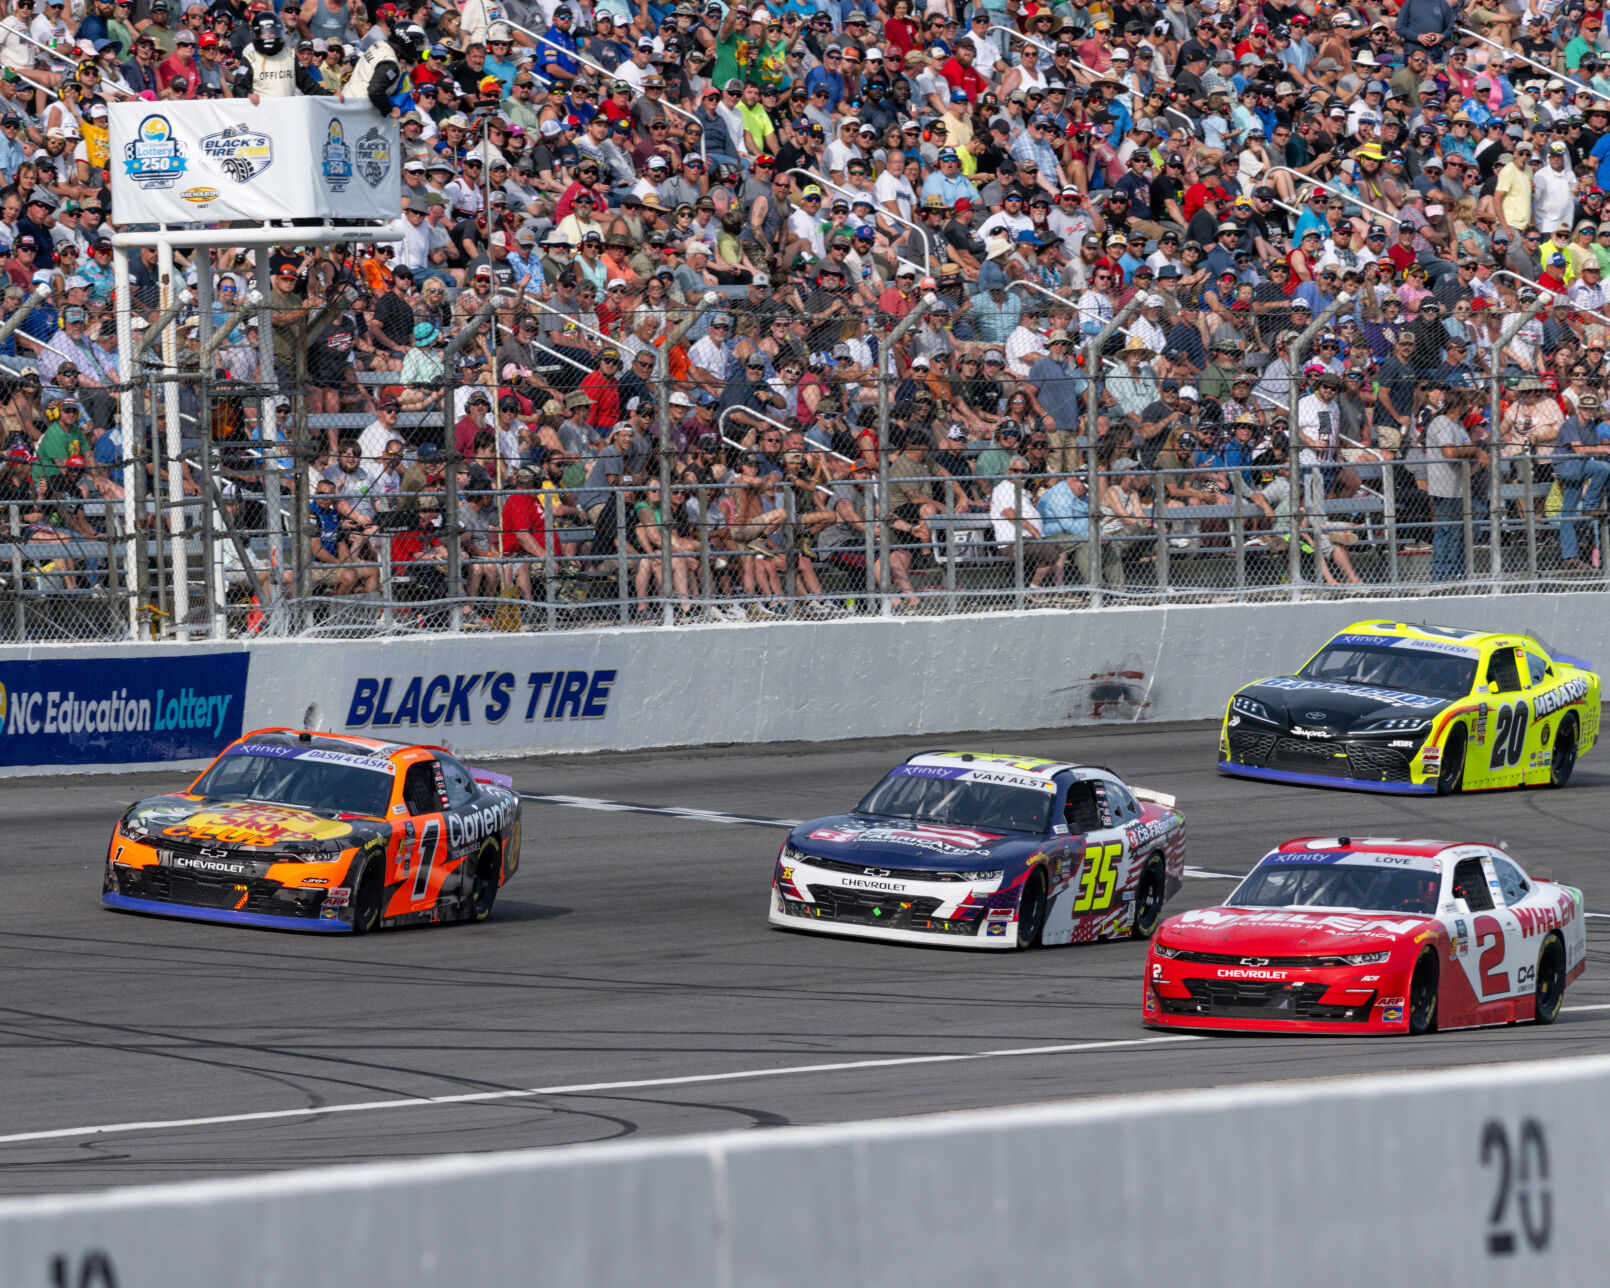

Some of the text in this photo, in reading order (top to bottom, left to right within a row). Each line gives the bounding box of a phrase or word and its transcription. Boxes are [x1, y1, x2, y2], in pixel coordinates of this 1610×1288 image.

[137, 147, 173, 156] Lottery
[204, 148, 236, 156] TIRE
[205, 138, 265, 148] BLACK'S
[140, 157, 170, 171] 250
[1342, 634, 1389, 645] xfinity
[1411, 640, 1434, 649] DASH
[1443, 645, 1469, 654] CASH
[345, 669, 617, 729] BLACK'S TIRE
[1533, 677, 1588, 721] MENARDS
[8, 688, 231, 738] NC Education Lottery
[1290, 726, 1333, 740] Supra
[1489, 698, 1529, 771] 20
[1387, 740, 1413, 748] JGR
[240, 743, 293, 756] xfinity
[308, 750, 343, 761] DASH
[353, 757, 388, 770] CASH
[902, 766, 1046, 788] xfinity VAN ALST
[162, 826, 281, 847] CLUB
[857, 832, 991, 856] FABRICATING
[115, 846, 125, 861] 1
[411, 820, 440, 901] 1
[1275, 852, 1411, 865] xfinity LOVE
[177, 858, 244, 873] CHEVROLET
[782, 867, 794, 879] 35
[841, 878, 907, 891] CHEVROLET
[1073, 843, 1121, 912] 35
[1181, 910, 1425, 935] WHELEN
[1508, 901, 1575, 939] WHELEN
[1325, 929, 1396, 942] AMERICA
[1473, 915, 1511, 997] 2
[1217, 969, 1287, 979] CHEVROLET
[1518, 965, 1535, 983] C4
[1479, 1117, 1553, 1256] 20
